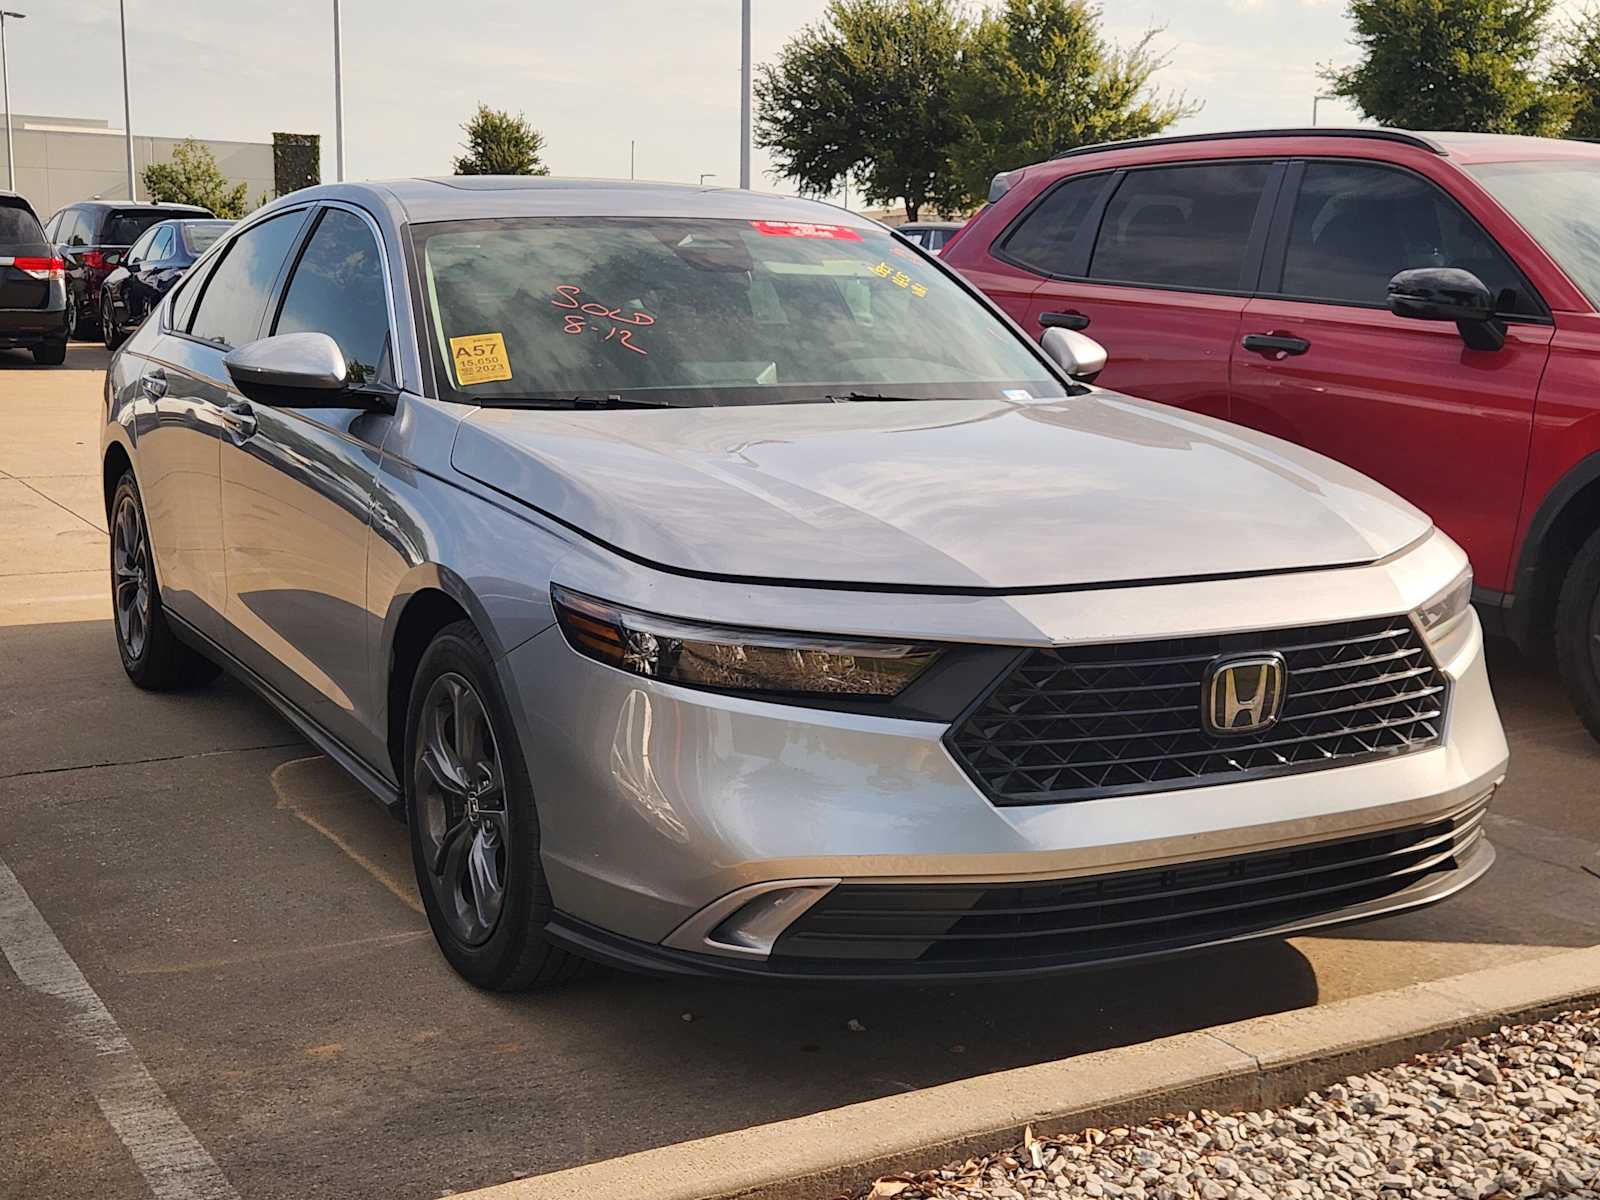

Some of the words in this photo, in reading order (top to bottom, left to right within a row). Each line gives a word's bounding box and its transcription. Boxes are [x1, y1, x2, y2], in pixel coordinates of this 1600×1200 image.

[551, 284, 656, 326] SOLD
[455, 343, 497, 359] A57
[563, 314, 648, 355] 8-12
